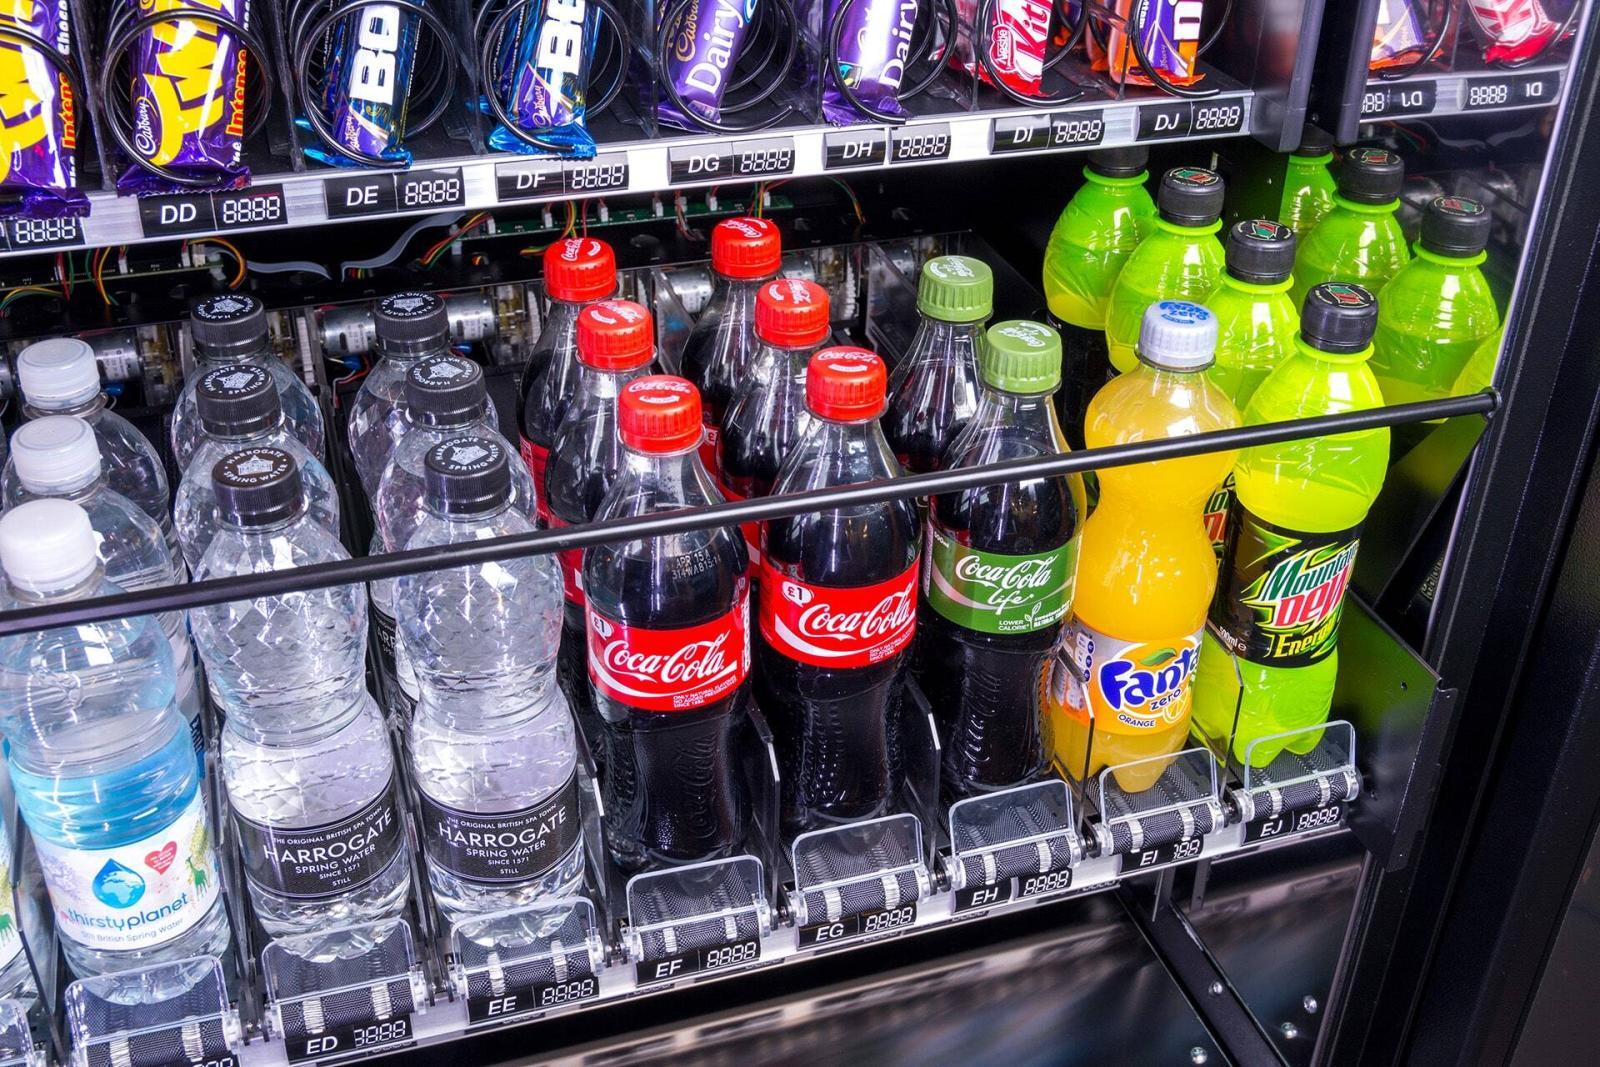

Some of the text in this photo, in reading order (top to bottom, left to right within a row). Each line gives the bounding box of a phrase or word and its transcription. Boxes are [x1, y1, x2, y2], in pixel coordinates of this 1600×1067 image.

[685, 0, 744, 94] Dairy
[135, 102, 156, 155] Cadbury
[1154, 113, 1180, 130] DJ
[1013, 127, 1033, 144] DI
[842, 141, 873, 159] DH
[688, 155, 720, 173] DG
[517, 171, 546, 189] DF
[346, 186, 379, 206] DE
[160, 204, 196, 224] DD
[227, 449, 284, 465] HARROGATE
[224, 463, 288, 483] SPRING WATER
[955, 554, 1059, 589] Coca-Cola
[787, 586, 803, 600] £1
[798, 578, 916, 640] Coca-Cola
[604, 630, 731, 684] Coca-Cola
[1100, 643, 1200, 710] Fanta
[1151, 688, 1181, 710] zero
[1118, 714, 1155, 728] ORANGE
[286, 836, 324, 846] ORIGINAL
[325, 827, 352, 841] BRITISH
[352, 819, 365, 831] SPA
[365, 806, 383, 825] TOWN
[460, 820, 496, 829] ORIGINAL
[497, 819, 524, 829] BRITISH
[525, 815, 538, 825] SPA
[538, 804, 557, 818] TOWN
[263, 808, 392, 865] HARROGATE
[438, 806, 567, 848] HARROGATE
[1260, 821, 1283, 838] EJ
[466, 839, 546, 858] SPRING WATER
[295, 844, 376, 875] SPRING WATER
[488, 858, 510, 866] SINCE
[1140, 850, 1158, 867] EI
[319, 869, 342, 880] SINCE
[500, 867, 519, 875] STILL
[332, 877, 352, 887] STILL
[971, 888, 998, 906] EH
[97, 934, 124, 943] British
[126, 929, 157, 944] Spring
[157, 918, 184, 934] Water
[815, 924, 844, 942] EG
[655, 959, 683, 978] EF
[488, 996, 517, 1016] EE
[306, 1035, 338, 1054] ED
